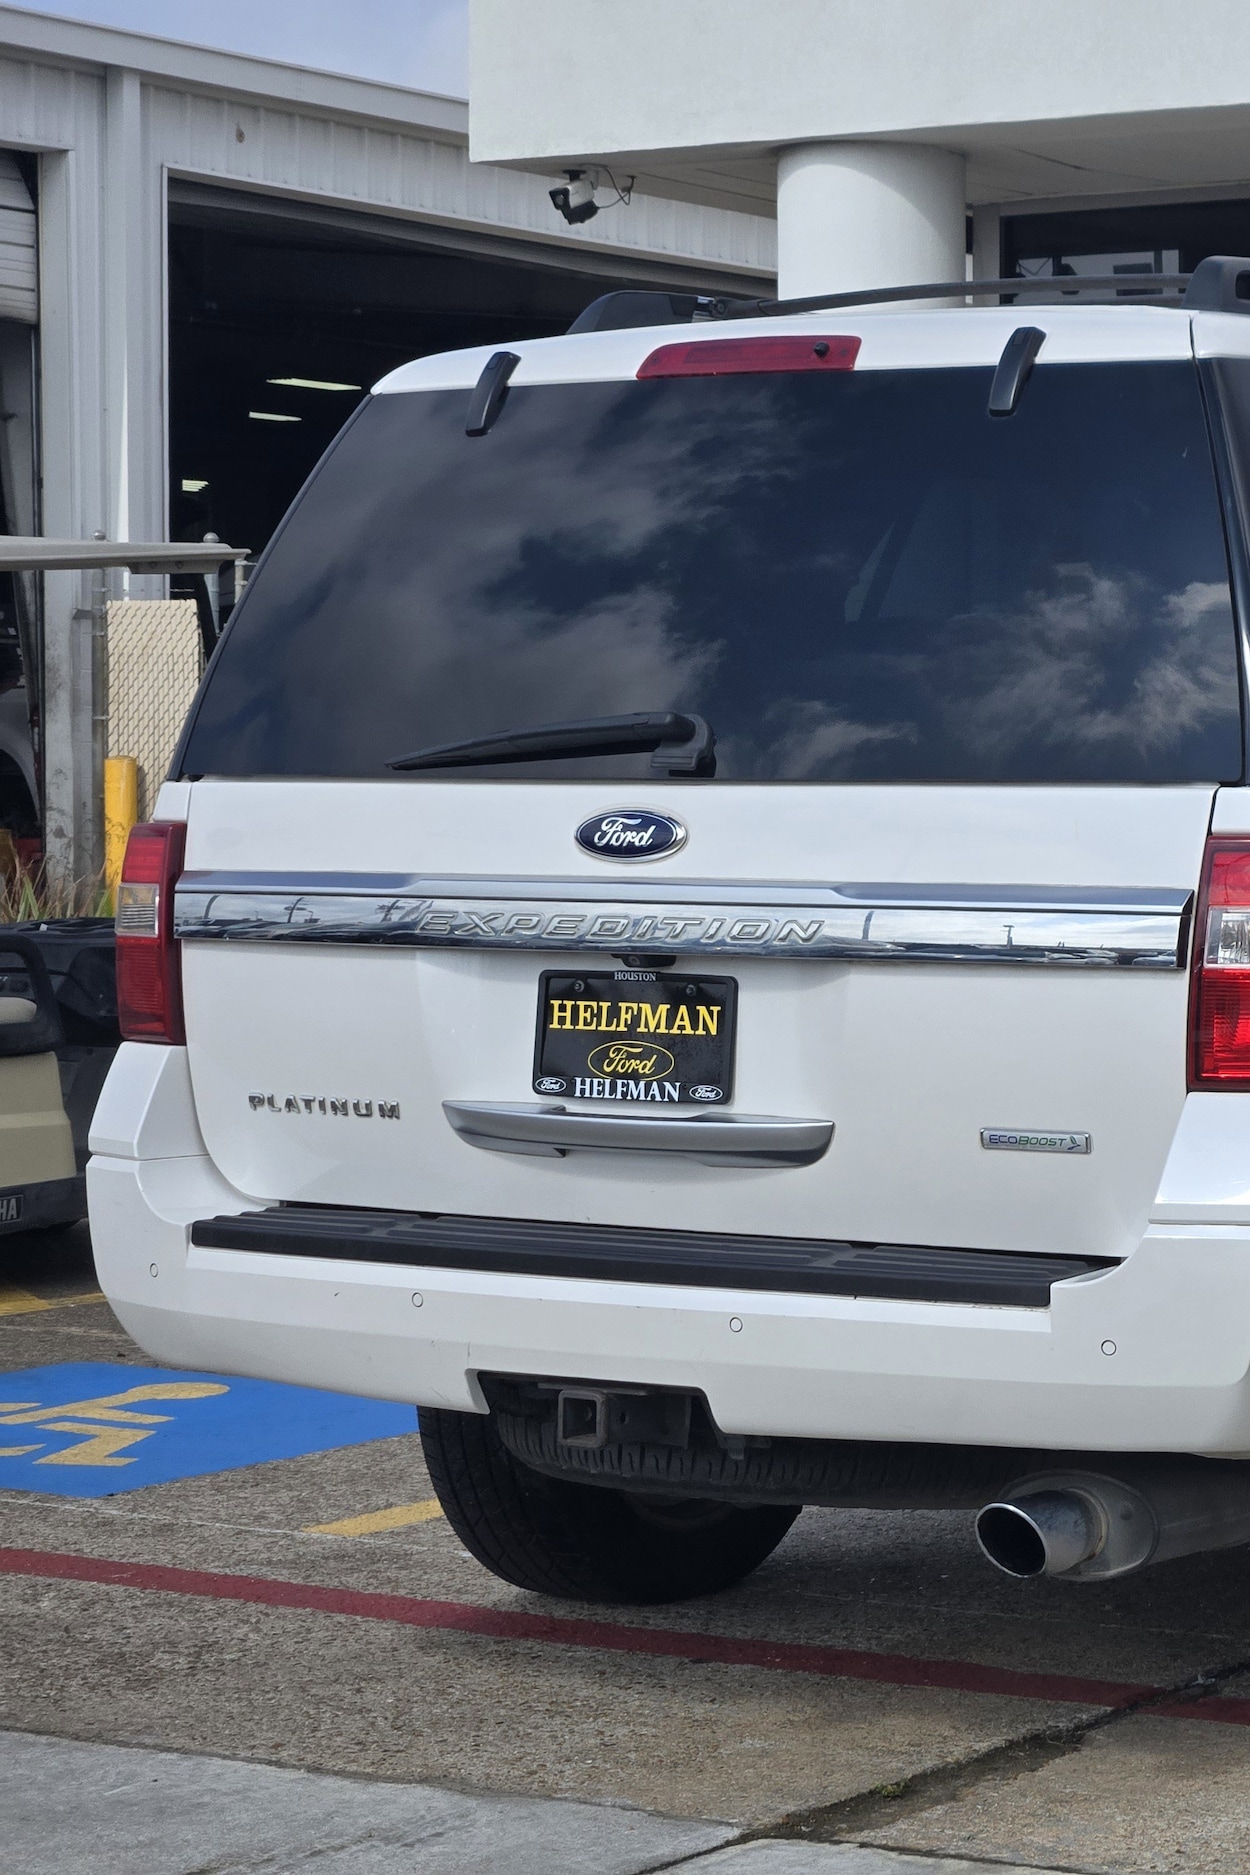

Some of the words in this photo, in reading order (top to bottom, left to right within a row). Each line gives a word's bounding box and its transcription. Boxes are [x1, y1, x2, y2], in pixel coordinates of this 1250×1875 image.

[594, 816, 656, 847] Ford
[417, 910, 825, 945] EXPEDITION
[614, 971, 656, 982] HOUSTON
[549, 1000, 721, 1036] HELFMAN
[603, 1045, 657, 1075] Ford
[540, 1078, 561, 1091] Ford
[574, 1077, 681, 1103] HELFMAN
[694, 1086, 717, 1099] Ford
[248, 1091, 400, 1121] PLATINUM
[988, 1134, 1067, 1147] ECOBOOST
